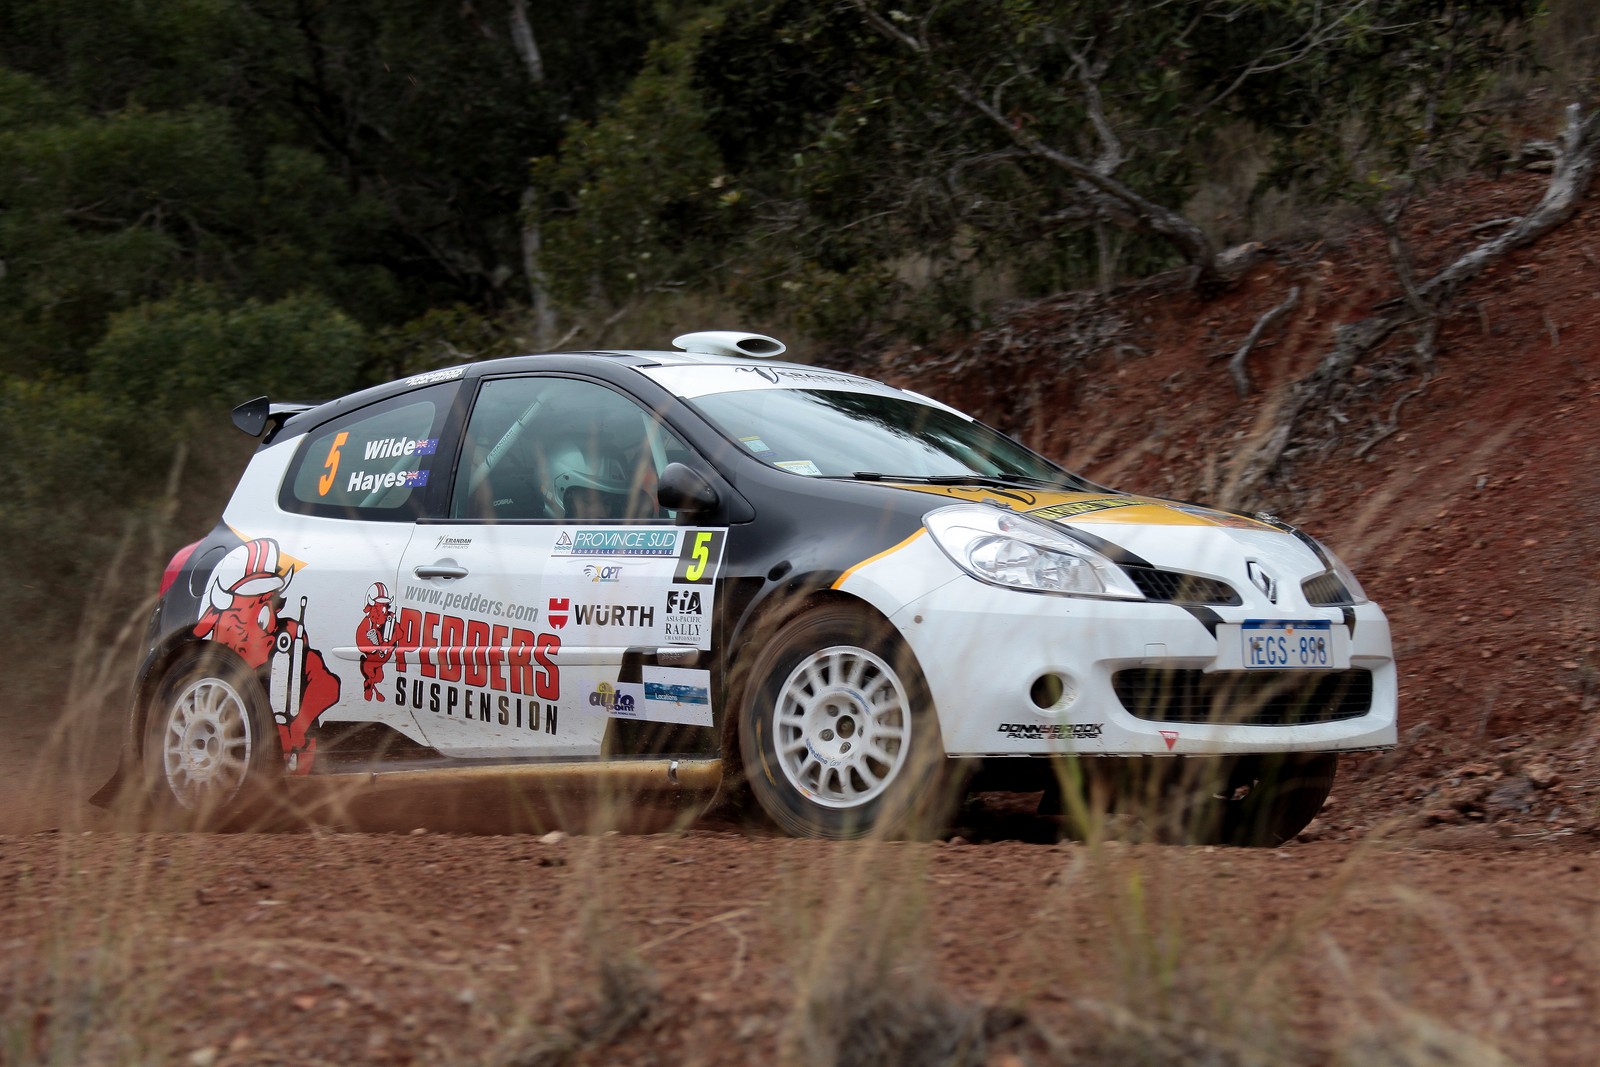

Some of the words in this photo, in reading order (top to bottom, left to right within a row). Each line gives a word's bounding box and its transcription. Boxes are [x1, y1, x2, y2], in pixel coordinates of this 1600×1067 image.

[364, 437, 416, 460] Wilde
[318, 432, 349, 497] 5
[347, 470, 407, 493] Hayes
[493, 498, 513, 507] COBRA
[574, 532, 646, 547] PROVINCE
[648, 532, 677, 547] SUD
[685, 532, 712, 581] 5
[601, 566, 623, 579] OPT
[405, 585, 539, 623] www.pedders.com
[575, 604, 654, 627] WÜRTH
[665, 623, 702, 636] RALLY
[396, 607, 562, 701] PEDDERS
[396, 676, 558, 736] SUSPENSION
[998, 723, 1104, 734] DONNYBROOK
